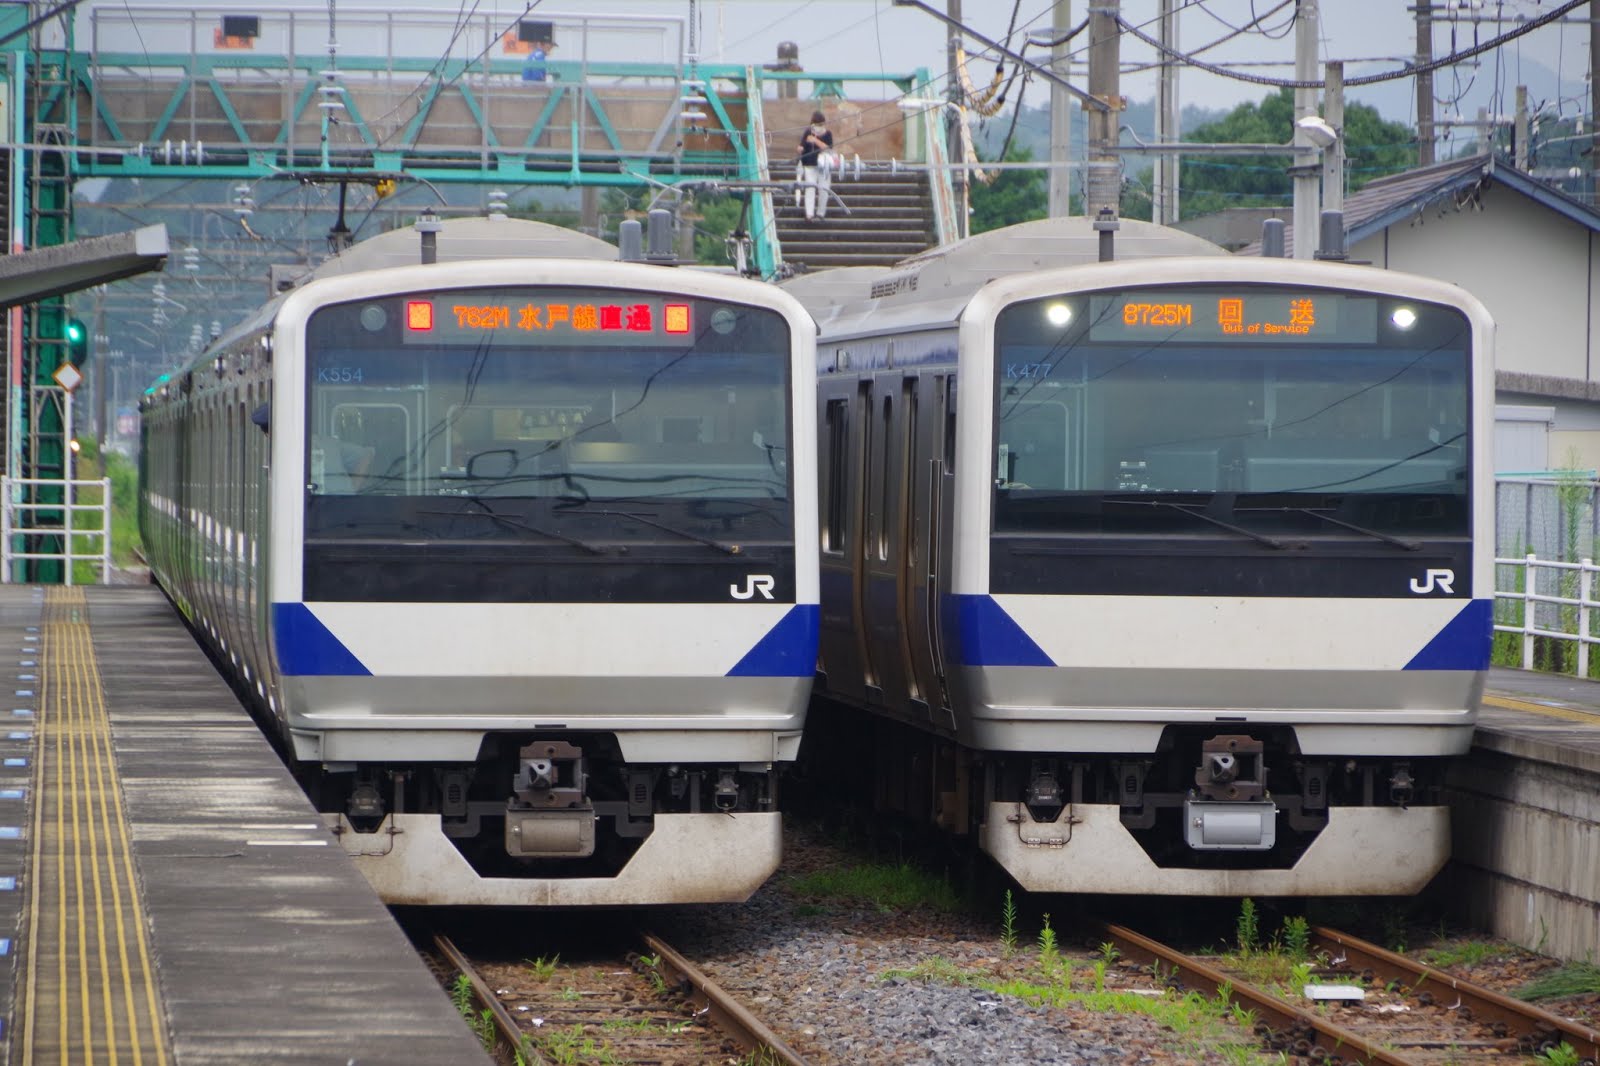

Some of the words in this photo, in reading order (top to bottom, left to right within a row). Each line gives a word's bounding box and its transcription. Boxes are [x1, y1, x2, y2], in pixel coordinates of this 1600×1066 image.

[453, 305, 510, 329] 762M
[1123, 303, 1192, 326] 8725M
[1218, 298, 1315, 325] 回送
[1223, 323, 1243, 334] Out
[1247, 323, 1260, 334] of
[1264, 323, 1310, 334] Service
[318, 367, 363, 382] K554
[1007, 363, 1052, 378] K477
[730, 574, 775, 600] JR
[1410, 568, 1455, 594] JR
